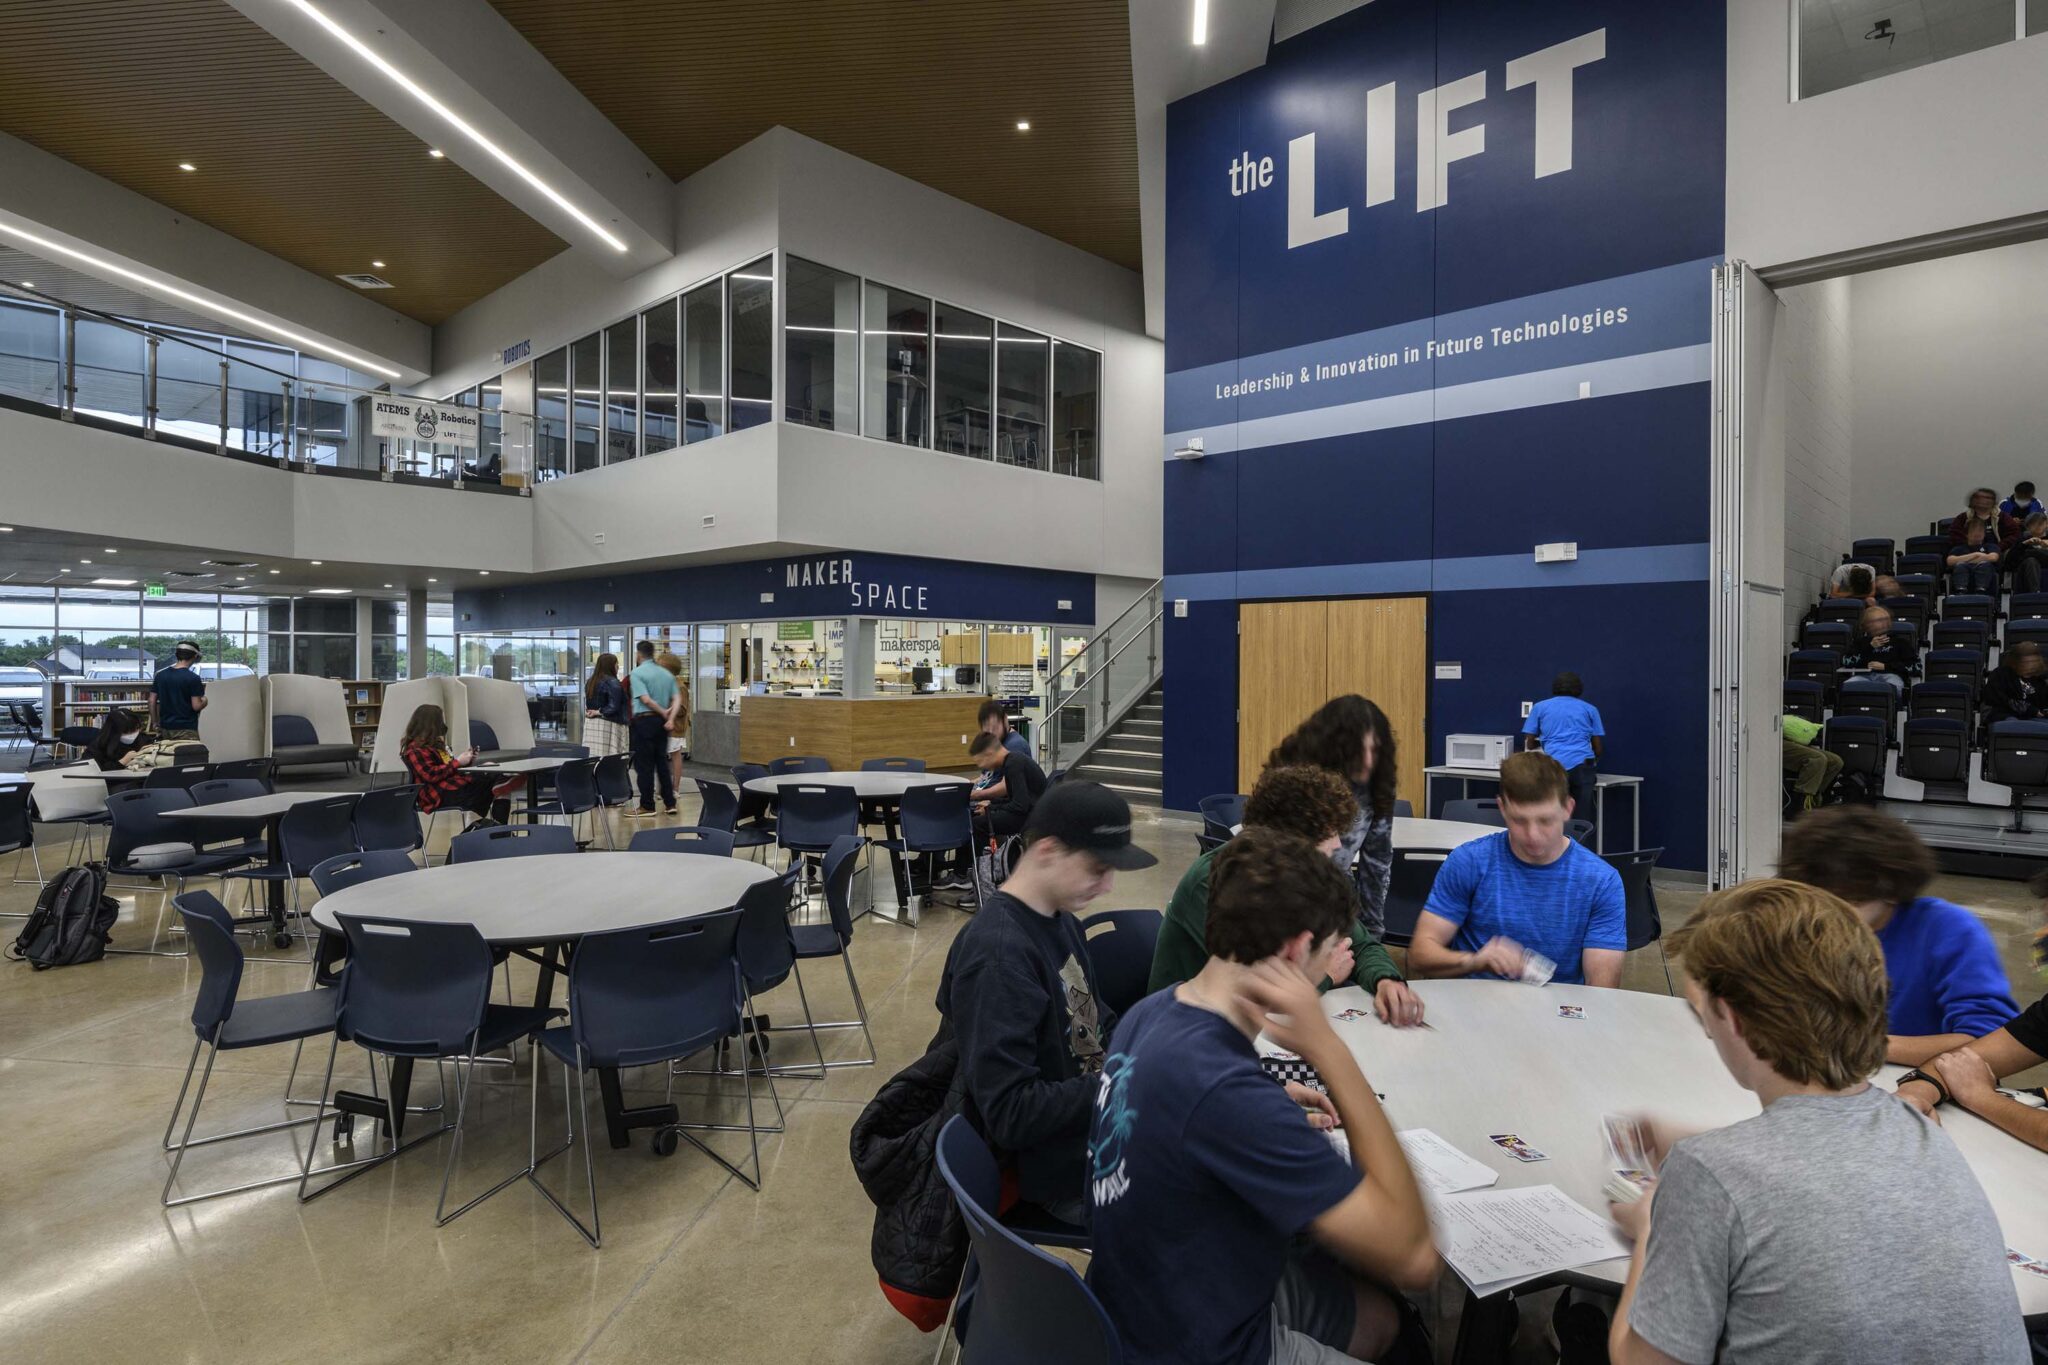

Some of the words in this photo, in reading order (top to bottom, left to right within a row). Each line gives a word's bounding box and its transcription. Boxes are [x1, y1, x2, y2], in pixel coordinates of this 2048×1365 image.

[1228, 151, 1274, 197] the
[1288, 27, 1606, 250] LIFT
[503, 339, 531, 365] ROBOTICS
[1216, 371, 1294, 399] Leadership
[1300, 366, 1310, 383] &
[1316, 352, 1398, 381] Innovation
[1404, 346, 1420, 364] in
[1426, 335, 1484, 360] Future
[1491, 306, 1629, 347] Technologies
[376, 402, 410, 416] ATEMS
[440, 412, 477, 426] Robotics
[786, 559, 853, 588] MAKER
[149, 586, 164, 596] EXIT
[851, 582, 928, 610] SPACE
[880, 637, 940, 654] makerspa
